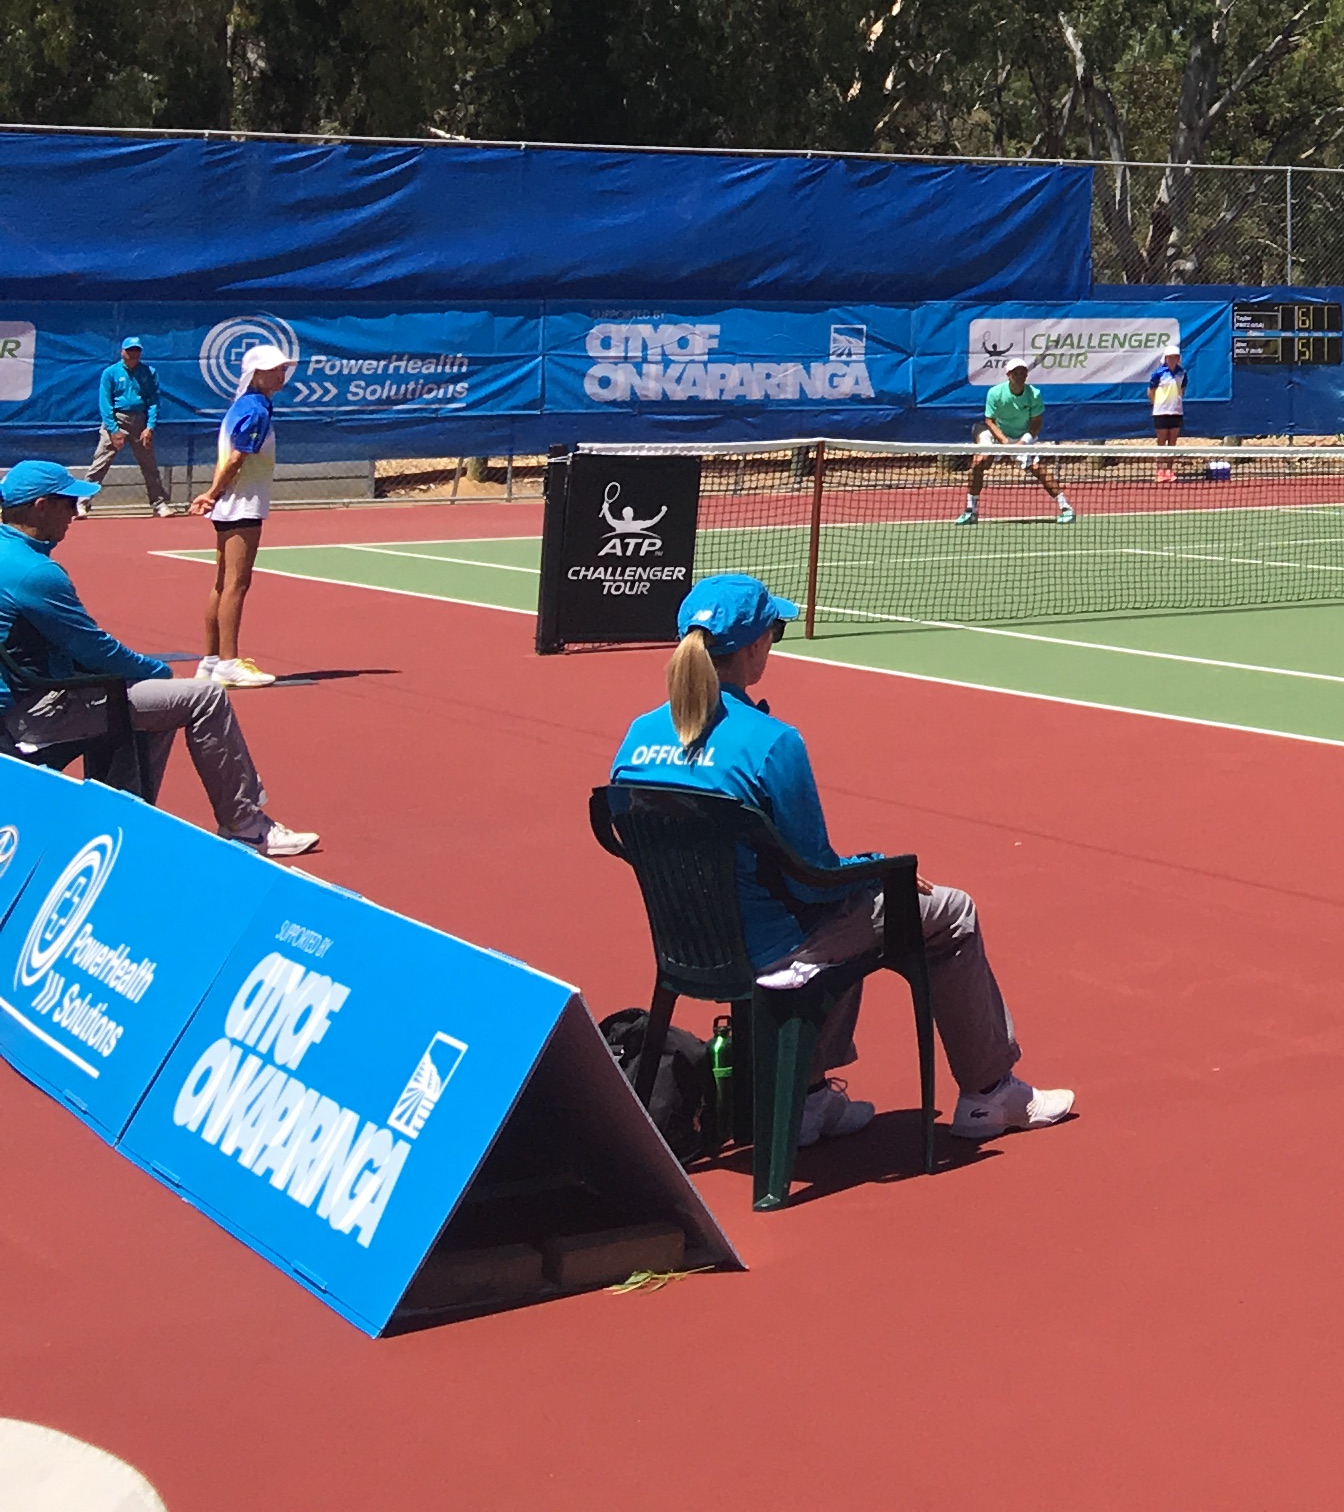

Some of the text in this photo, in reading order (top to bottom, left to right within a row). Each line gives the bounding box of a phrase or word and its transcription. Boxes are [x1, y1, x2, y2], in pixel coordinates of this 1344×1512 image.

[1298, 308, 1310, 328] 6
[1030, 332, 1171, 350] CHALLENGER
[1298, 339, 1310, 361] 5
[306, 353, 469, 376] PowerHealth
[1031, 352, 1089, 369] TOUR
[346, 378, 469, 402] Solutions
[584, 362, 876, 402] ONKAPARINGA
[597, 538, 663, 557] ATP
[567, 566, 687, 580] CHALLENGER
[602, 581, 651, 595] TOUR
[631, 745, 716, 767] OFFICIAL
[274, 919, 335, 958] SUPPORTED BY
[64, 922, 158, 1004] PowerHealth
[52, 983, 124, 1058] Solutions
[173, 1037, 412, 1249] ONKAPARINGA
